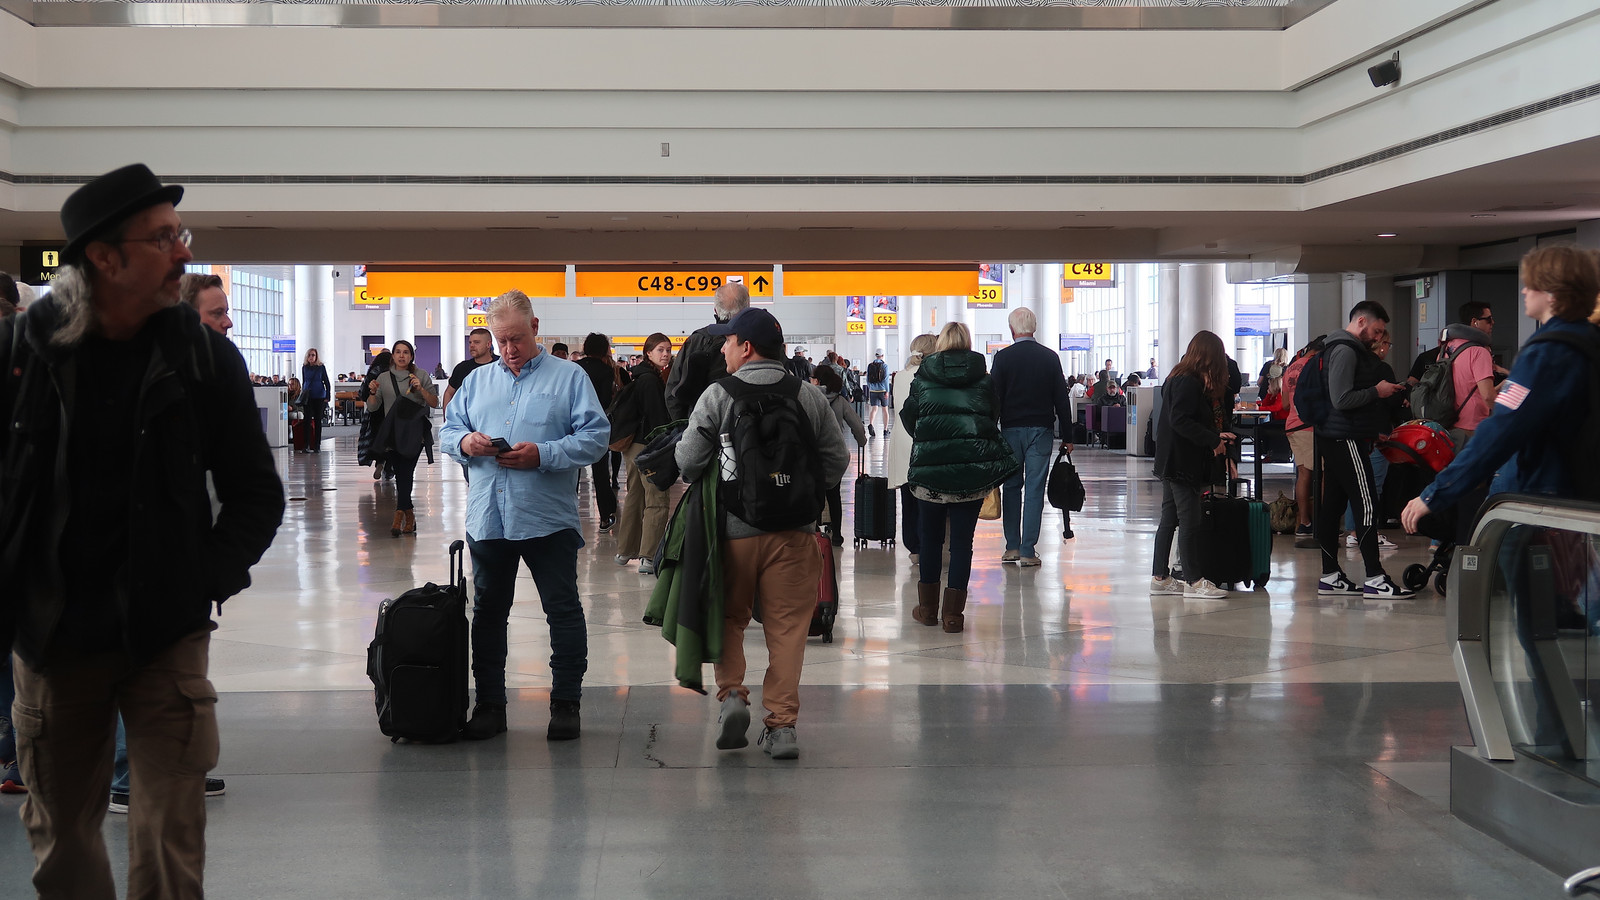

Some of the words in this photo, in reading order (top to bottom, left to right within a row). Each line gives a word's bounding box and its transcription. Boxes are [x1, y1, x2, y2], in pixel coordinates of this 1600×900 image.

[1071, 262, 1103, 275] C48
[637, 276, 722, 291] C48-C99
[877, 315, 893, 324] C52
[850, 323, 864, 331] C54
[775, 473, 791, 487] Lite
